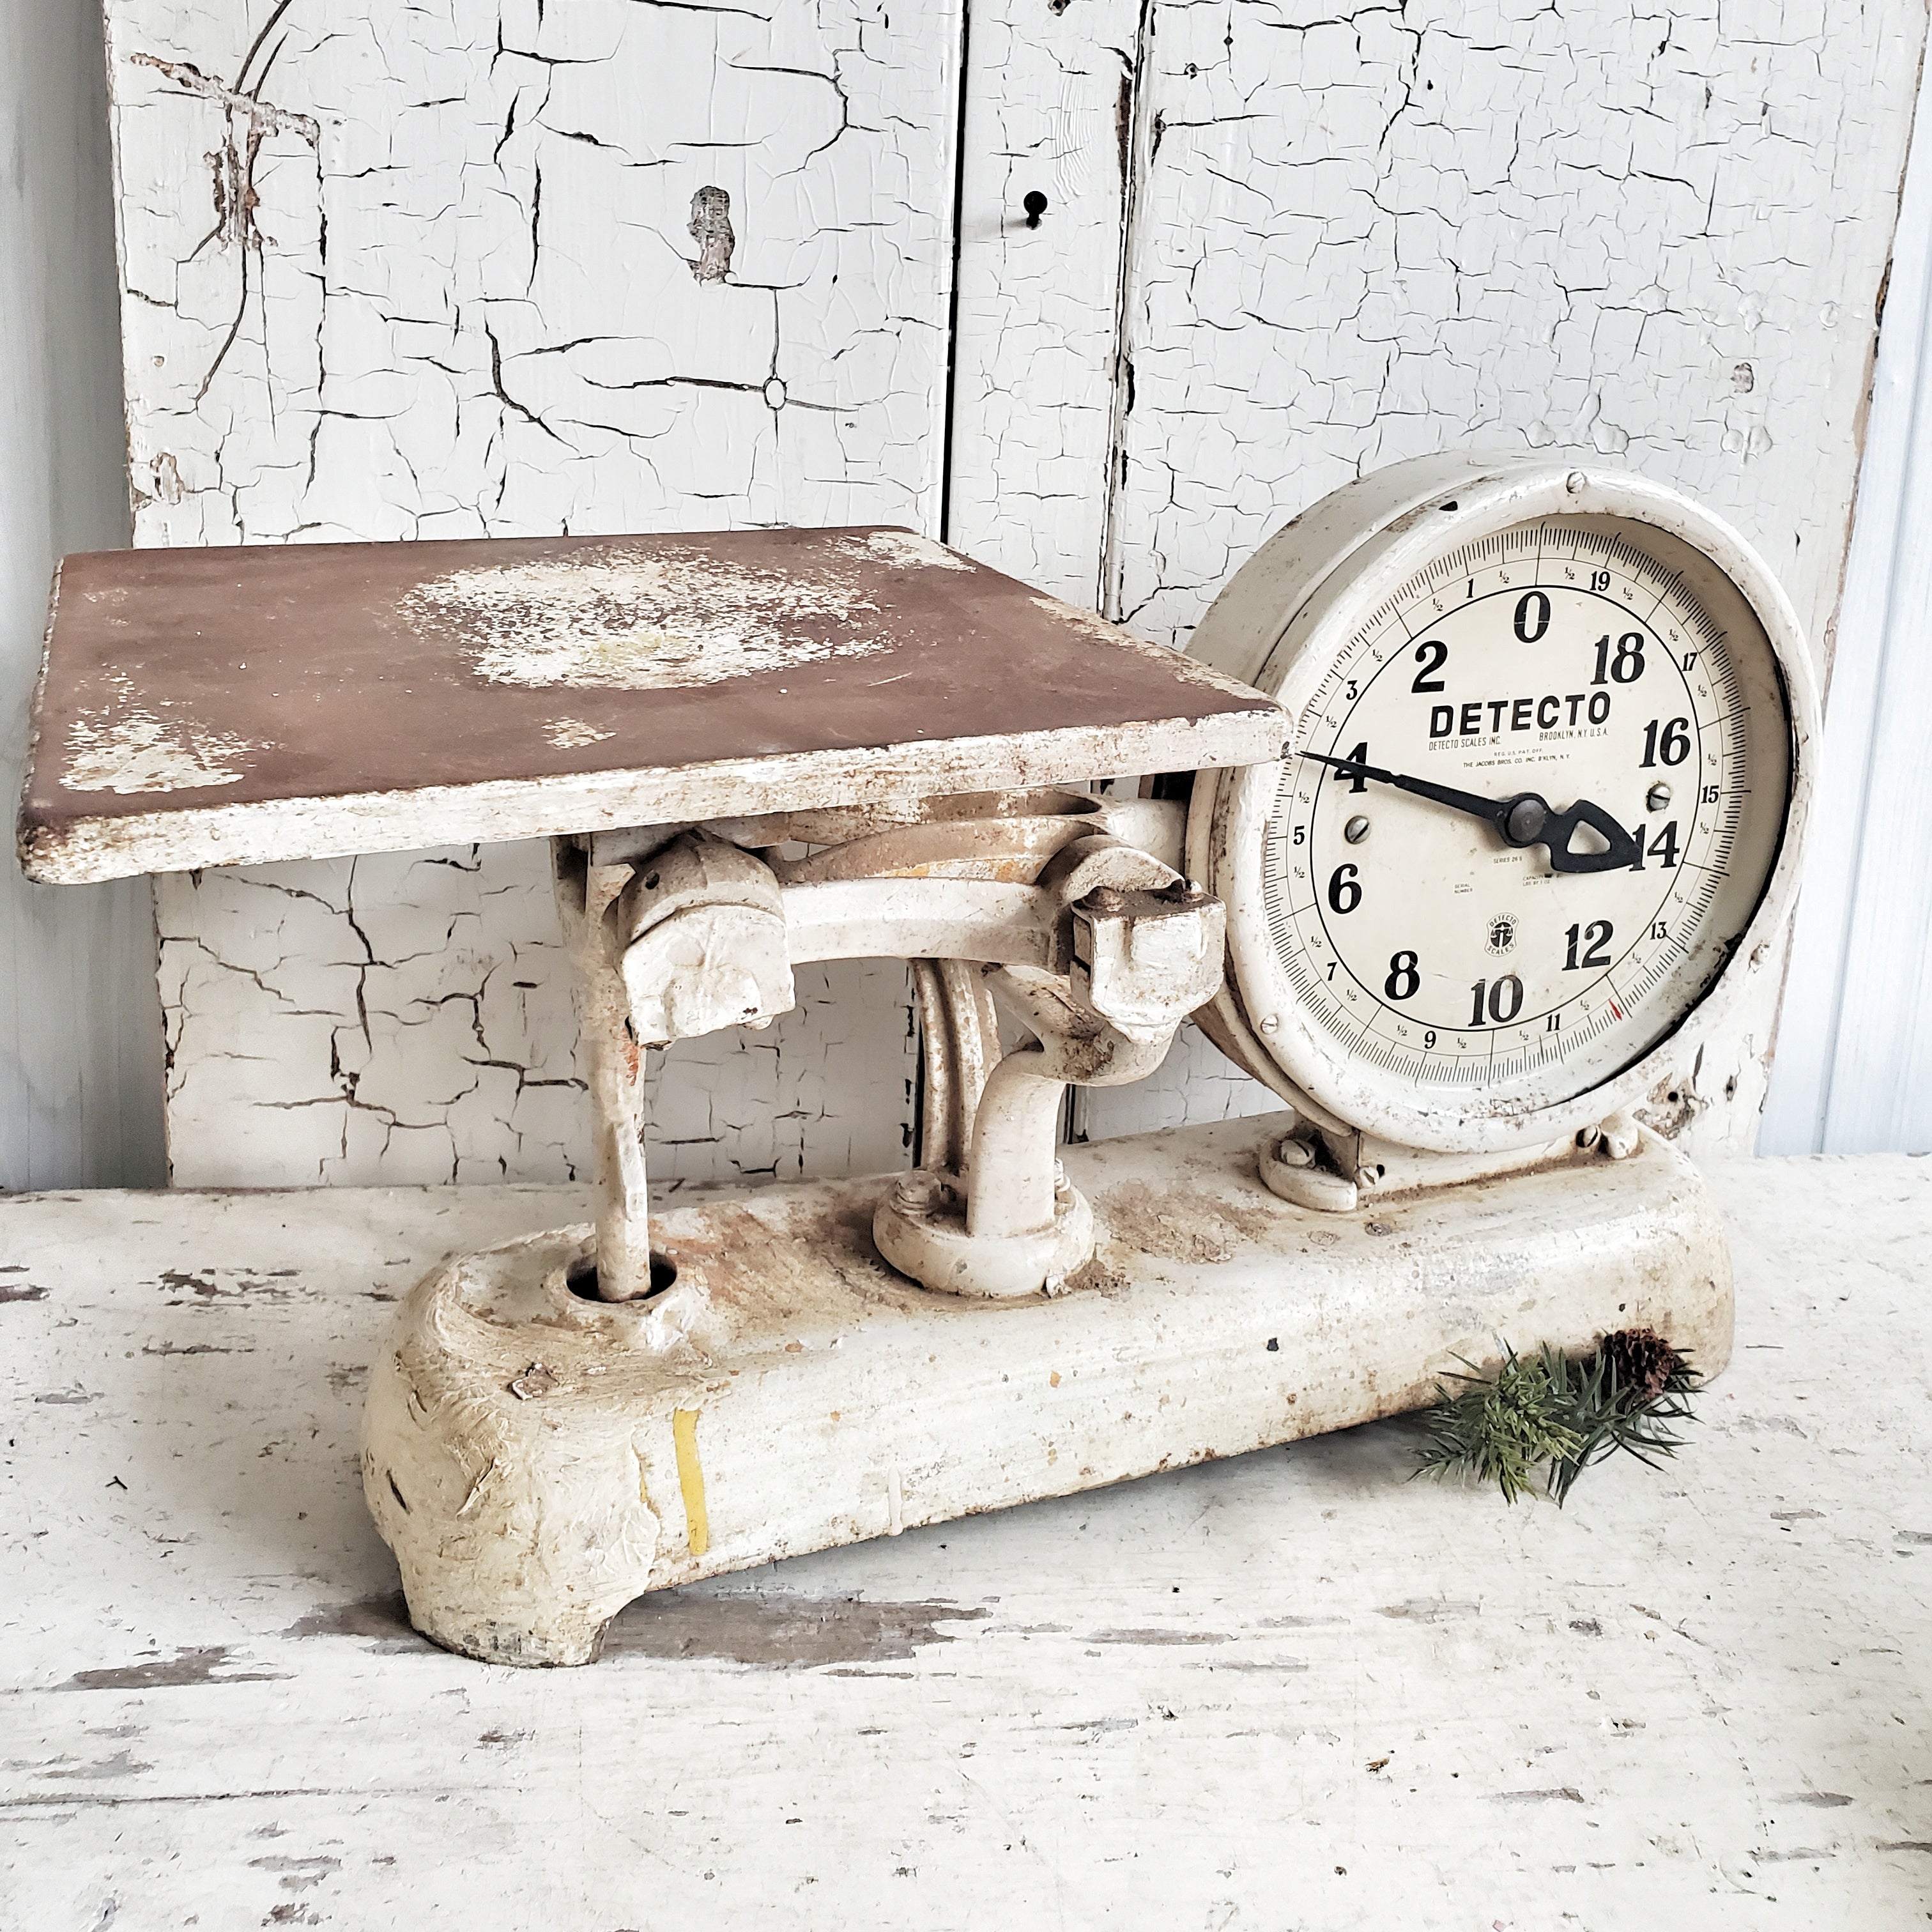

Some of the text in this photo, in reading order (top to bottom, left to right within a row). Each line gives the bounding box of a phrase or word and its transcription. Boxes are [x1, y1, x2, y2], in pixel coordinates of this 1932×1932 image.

[1466, 578, 1475, 599] 1
[1590, 571, 1611, 592] 19
[1514, 591, 1551, 643] 0
[1411, 640, 1448, 693] 2
[1590, 632, 1645, 685] 18
[1681, 652, 1698, 671] 17
[1346, 679, 1359, 701] 3
[1429, 691, 1611, 739] DETECTO
[1429, 739, 1459, 751] DETECTO
[1460, 737, 1487, 748] SCALES
[1639, 717, 1691, 769] 16
[1333, 742, 1368, 794] 4
[1701, 785, 1720, 804] 15
[1293, 825, 1305, 845] 5
[1629, 820, 1680, 872] 14
[1328, 863, 1363, 914] 6
[1489, 914, 1517, 928] DETECTO
[1650, 921, 1667, 940] 13
[1487, 942, 1514, 955] SCALES
[1561, 919, 1614, 971] 12
[1326, 962, 1337, 981] 7
[1384, 950, 1420, 1000] 8
[1468, 974, 1524, 1027] 10
[1545, 1013, 1561, 1032] 11
[1424, 1031, 1437, 1049] 9
